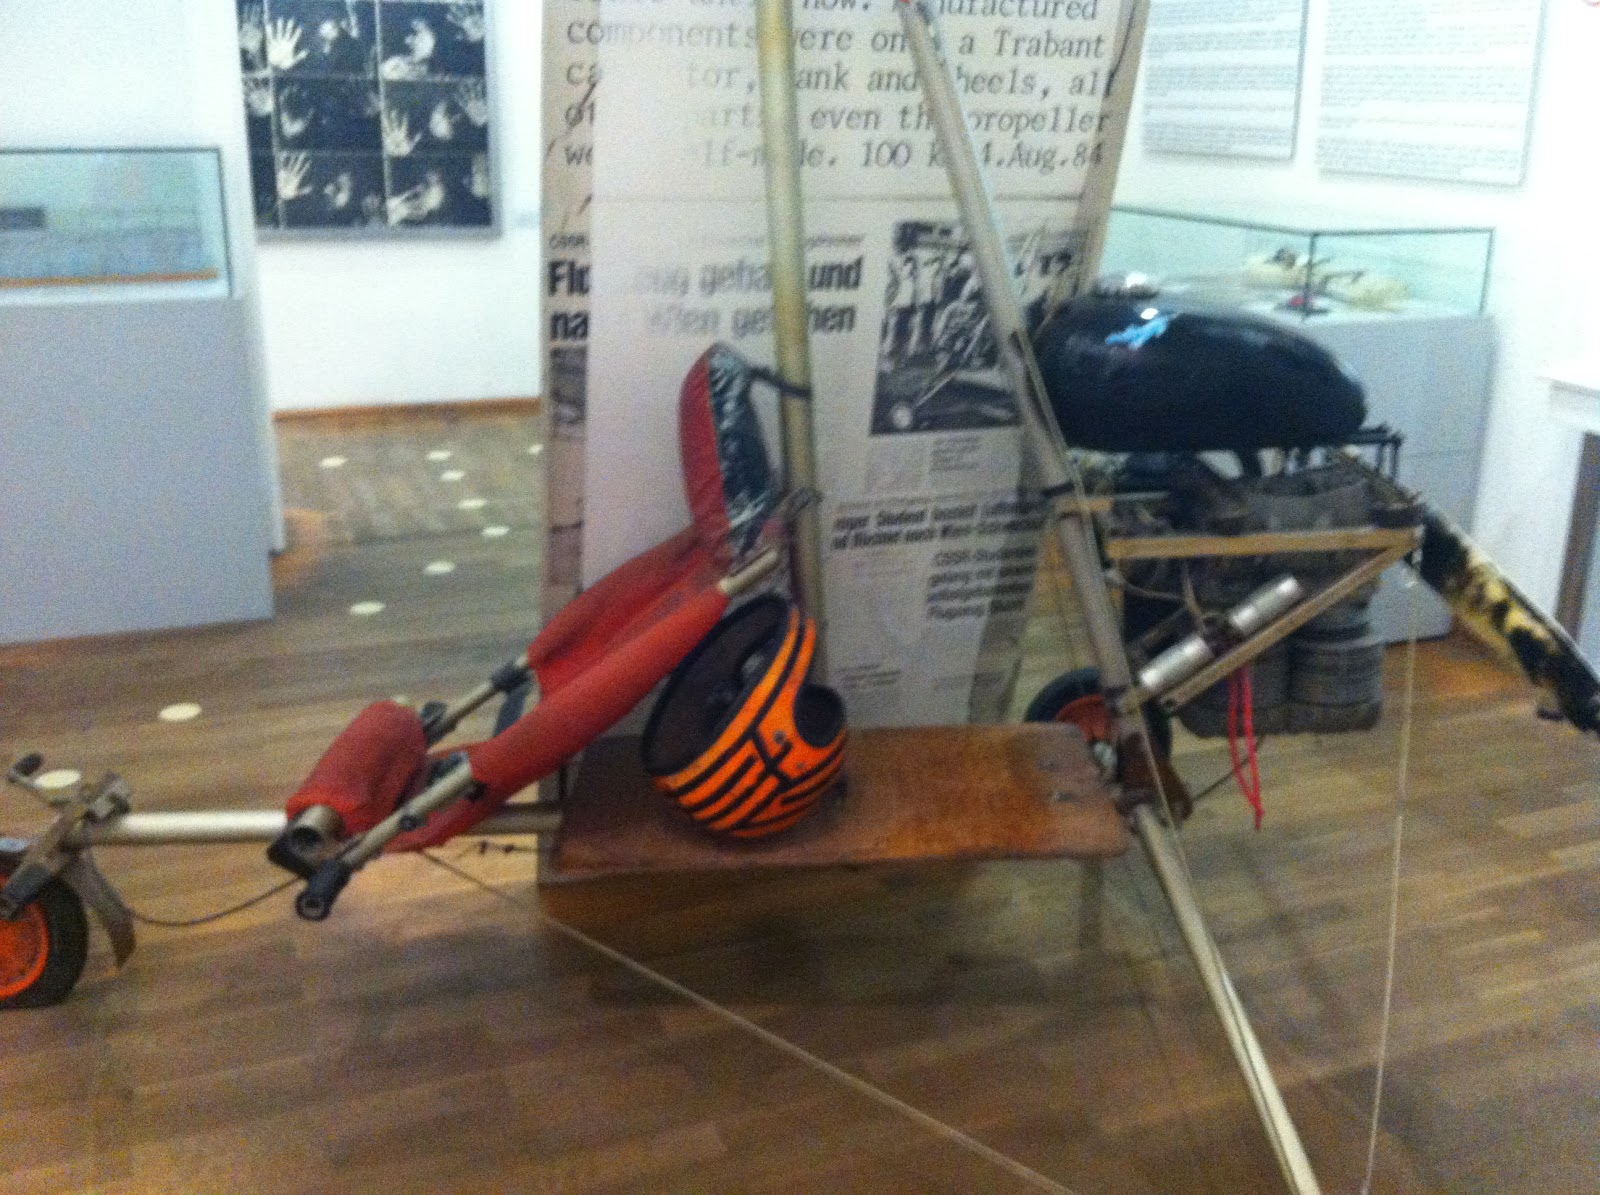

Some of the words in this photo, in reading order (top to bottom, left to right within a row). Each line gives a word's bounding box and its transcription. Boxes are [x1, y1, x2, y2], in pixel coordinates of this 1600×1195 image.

[794, 29, 852, 52] ere
[993, 28, 1104, 59] Trabant
[795, 61, 849, 91] ank
[956, 65, 1050, 100] heels,
[810, 108, 881, 131] even
[900, 105, 936, 131] th
[862, 141, 912, 168] 100
[808, 255, 864, 293] und
